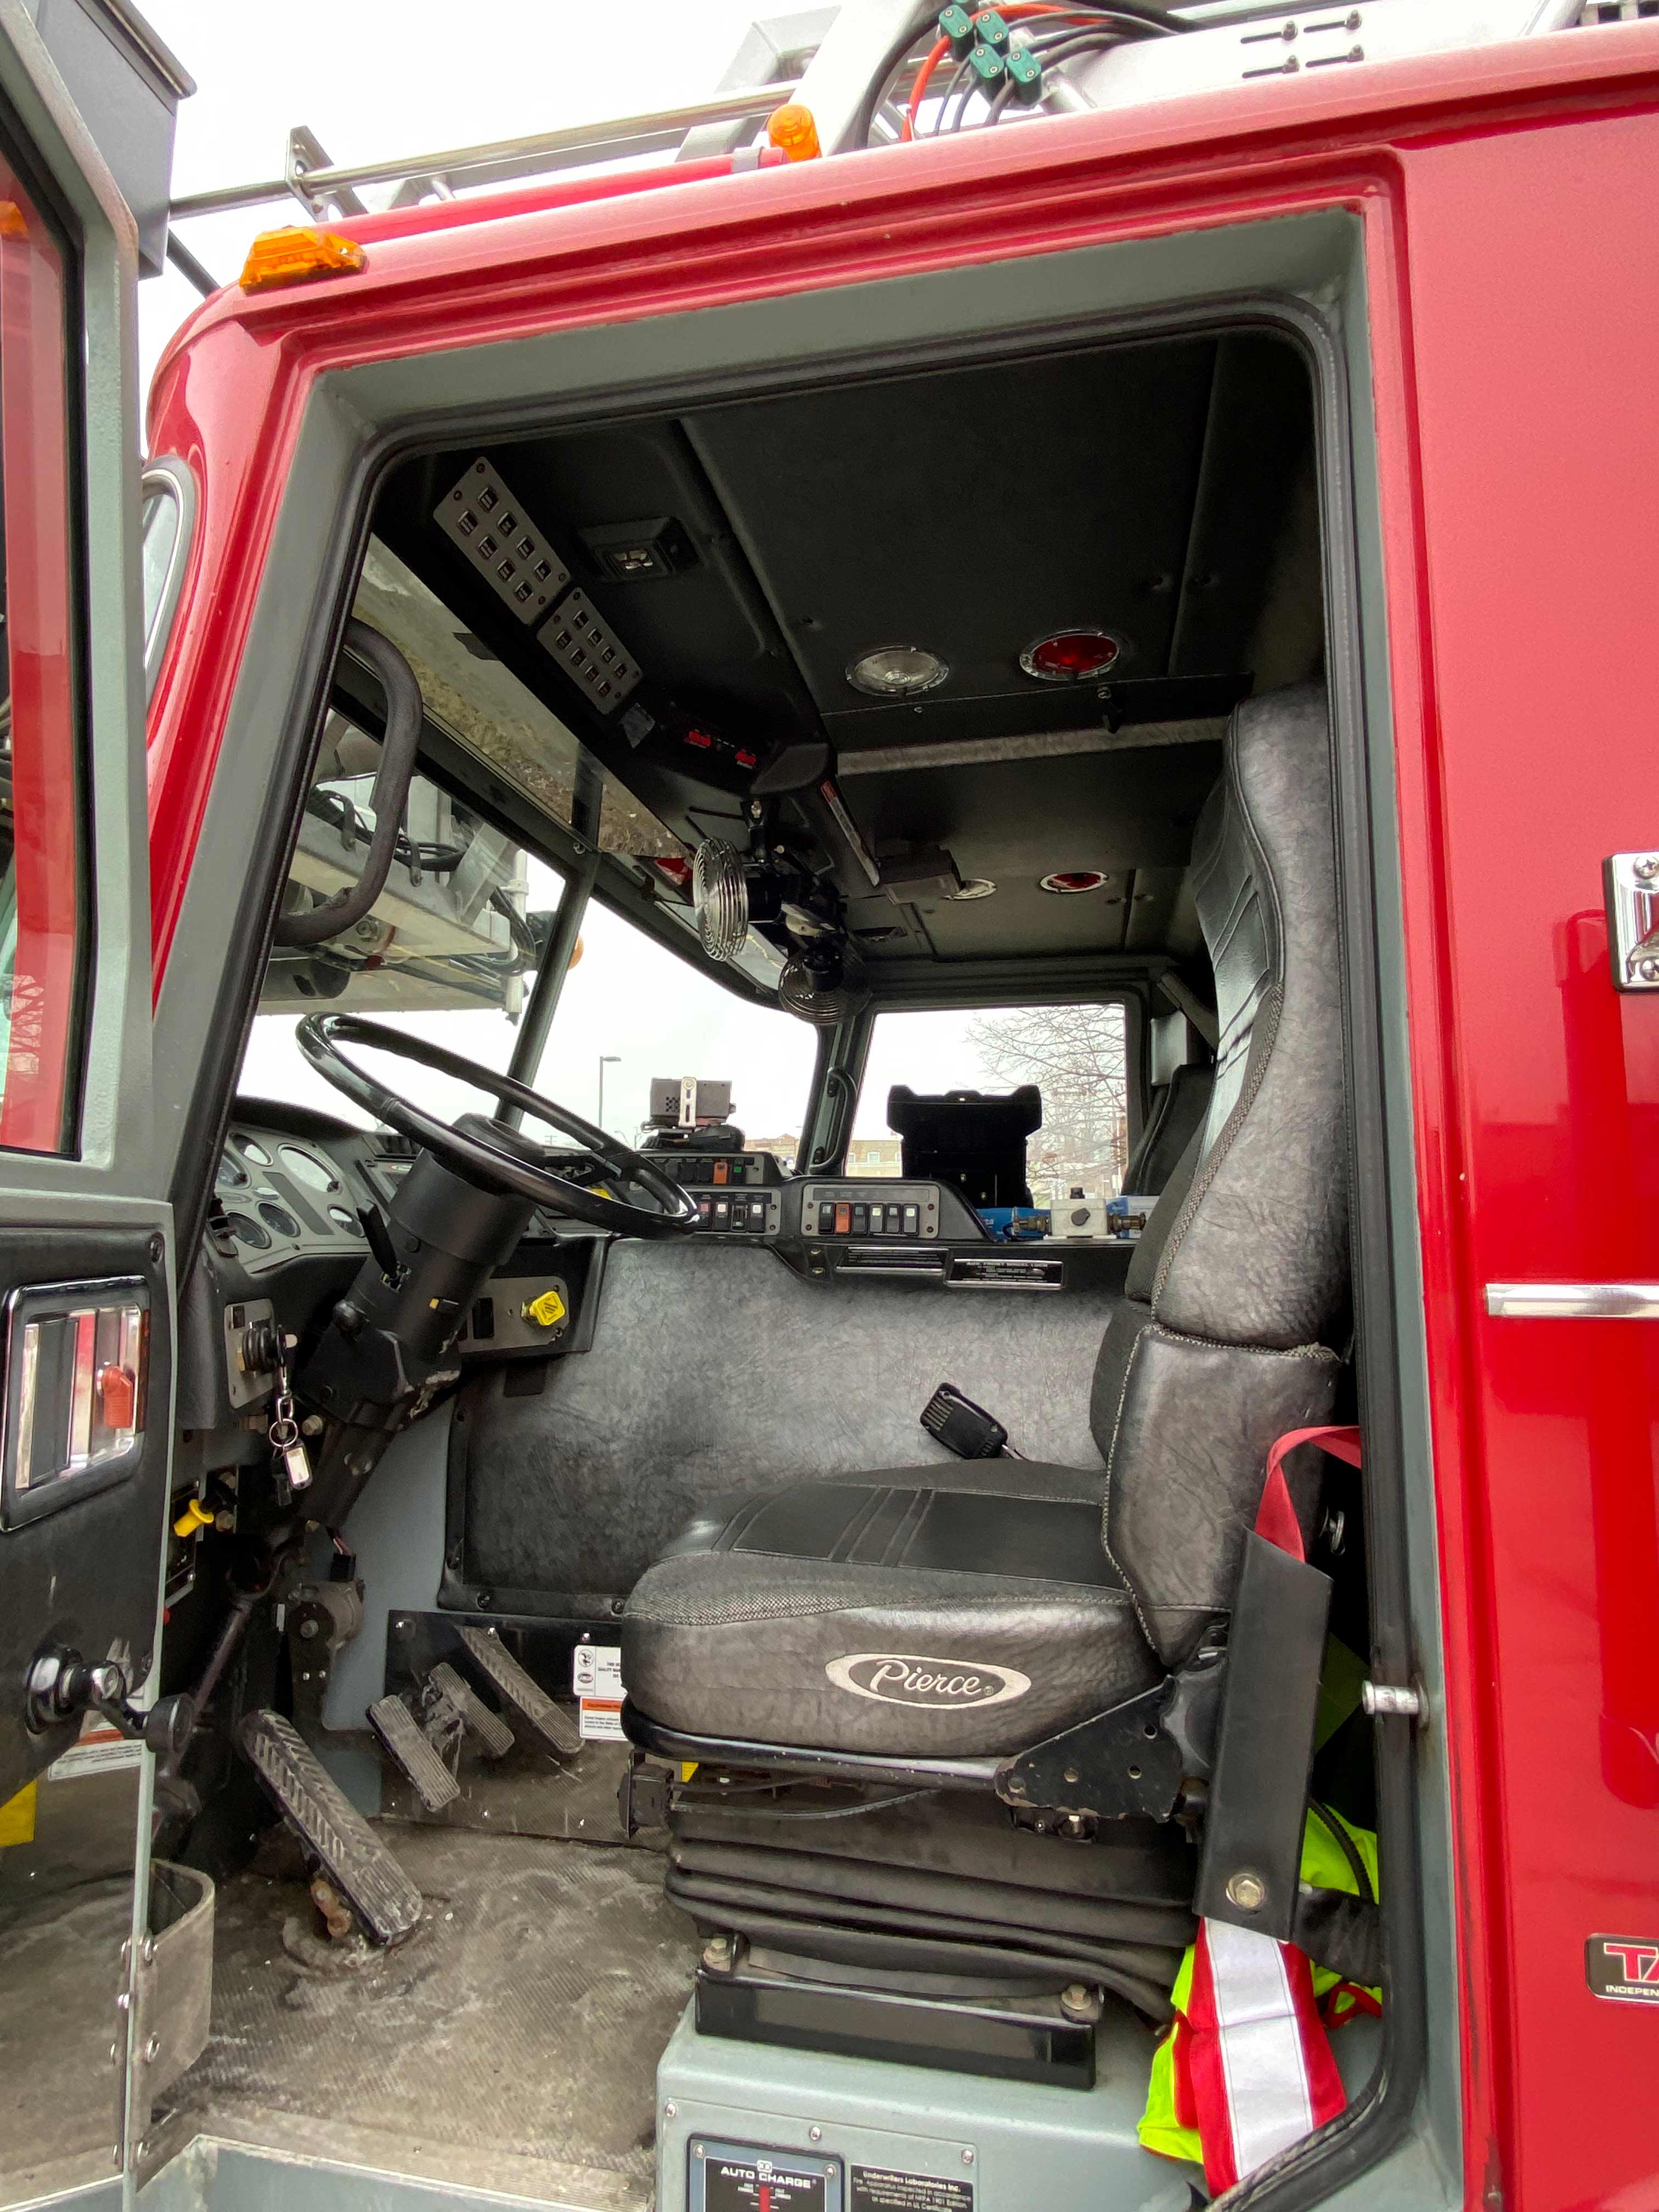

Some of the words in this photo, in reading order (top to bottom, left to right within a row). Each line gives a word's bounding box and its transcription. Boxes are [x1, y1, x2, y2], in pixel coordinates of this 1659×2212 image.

[870, 1660, 981, 1696] Pierce
[720, 2166, 755, 2179] AUTO
[759, 2172, 811, 2188] CHARGE
[905, 2177, 946, 2190] Laboratories
[948, 2183, 961, 2192] Inc.
